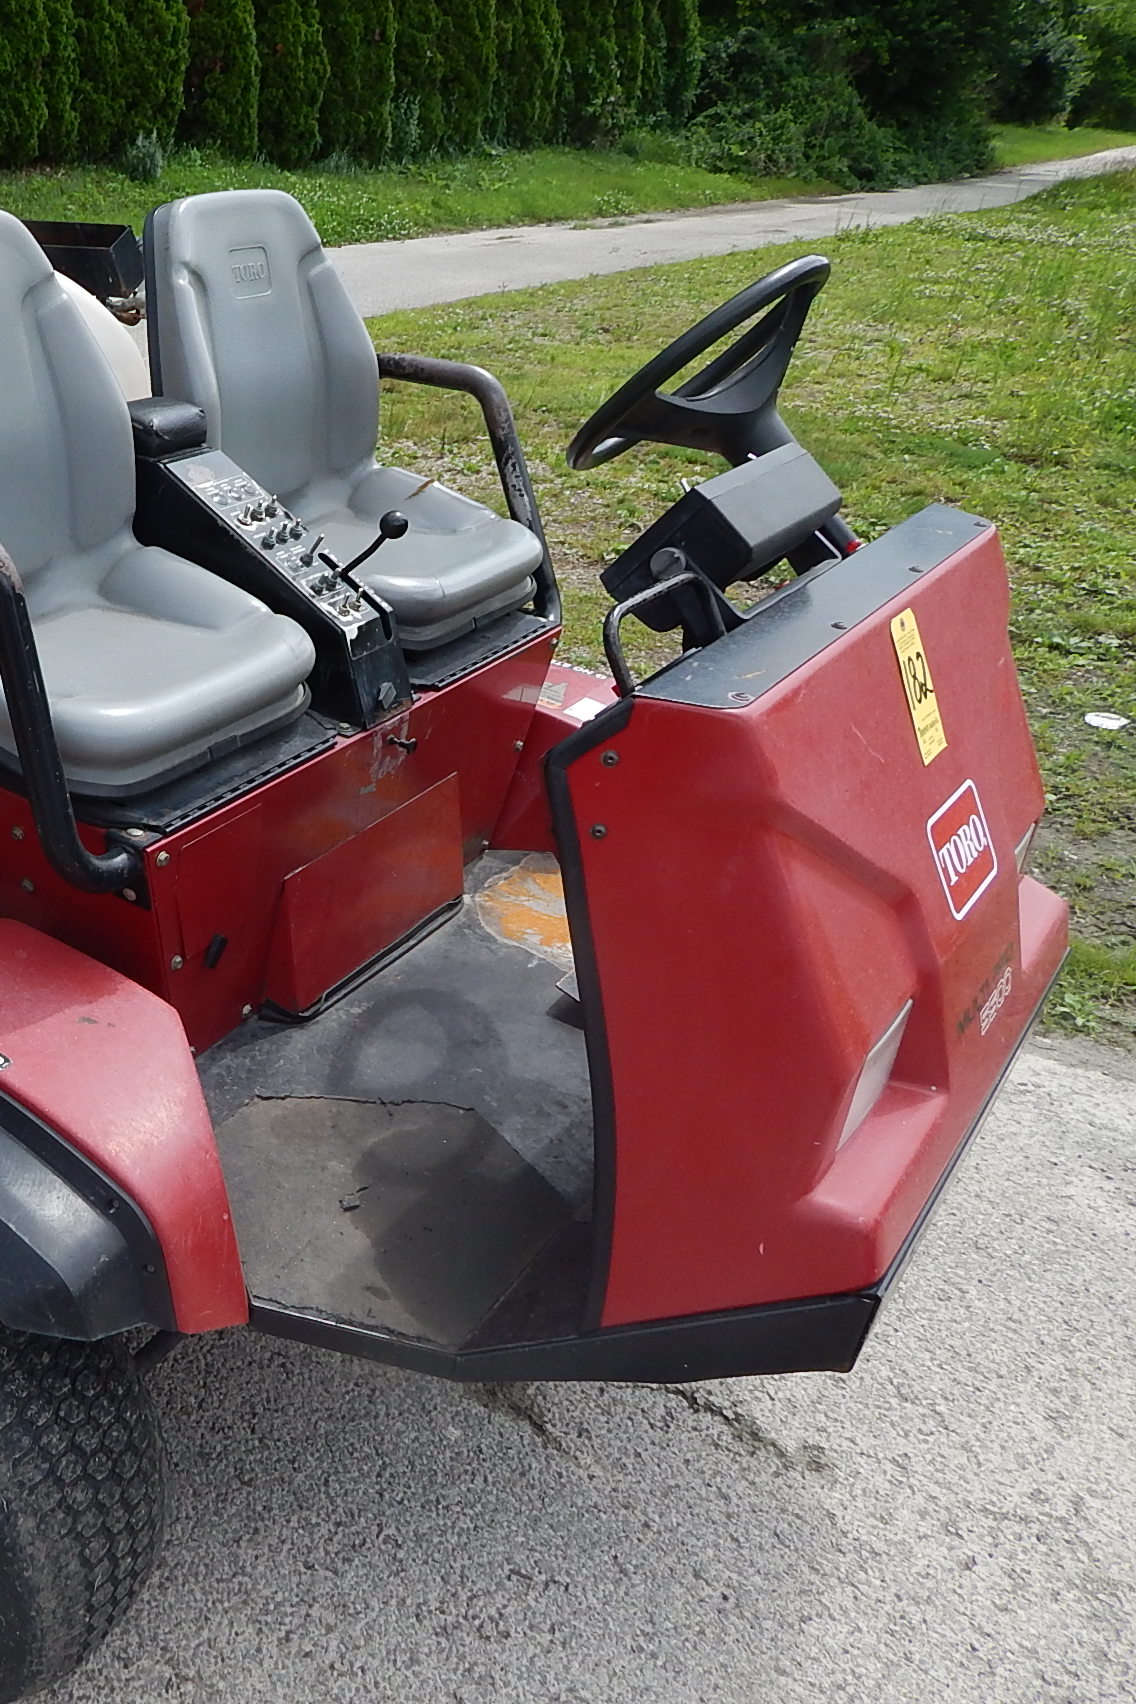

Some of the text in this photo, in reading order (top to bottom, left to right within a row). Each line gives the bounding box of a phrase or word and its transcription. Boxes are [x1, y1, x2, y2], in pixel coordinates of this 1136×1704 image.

[231, 261, 265, 283] TORO
[902, 651, 934, 711] 182
[938, 814, 988, 886] TORO
[979, 966, 1012, 1036] 5500
